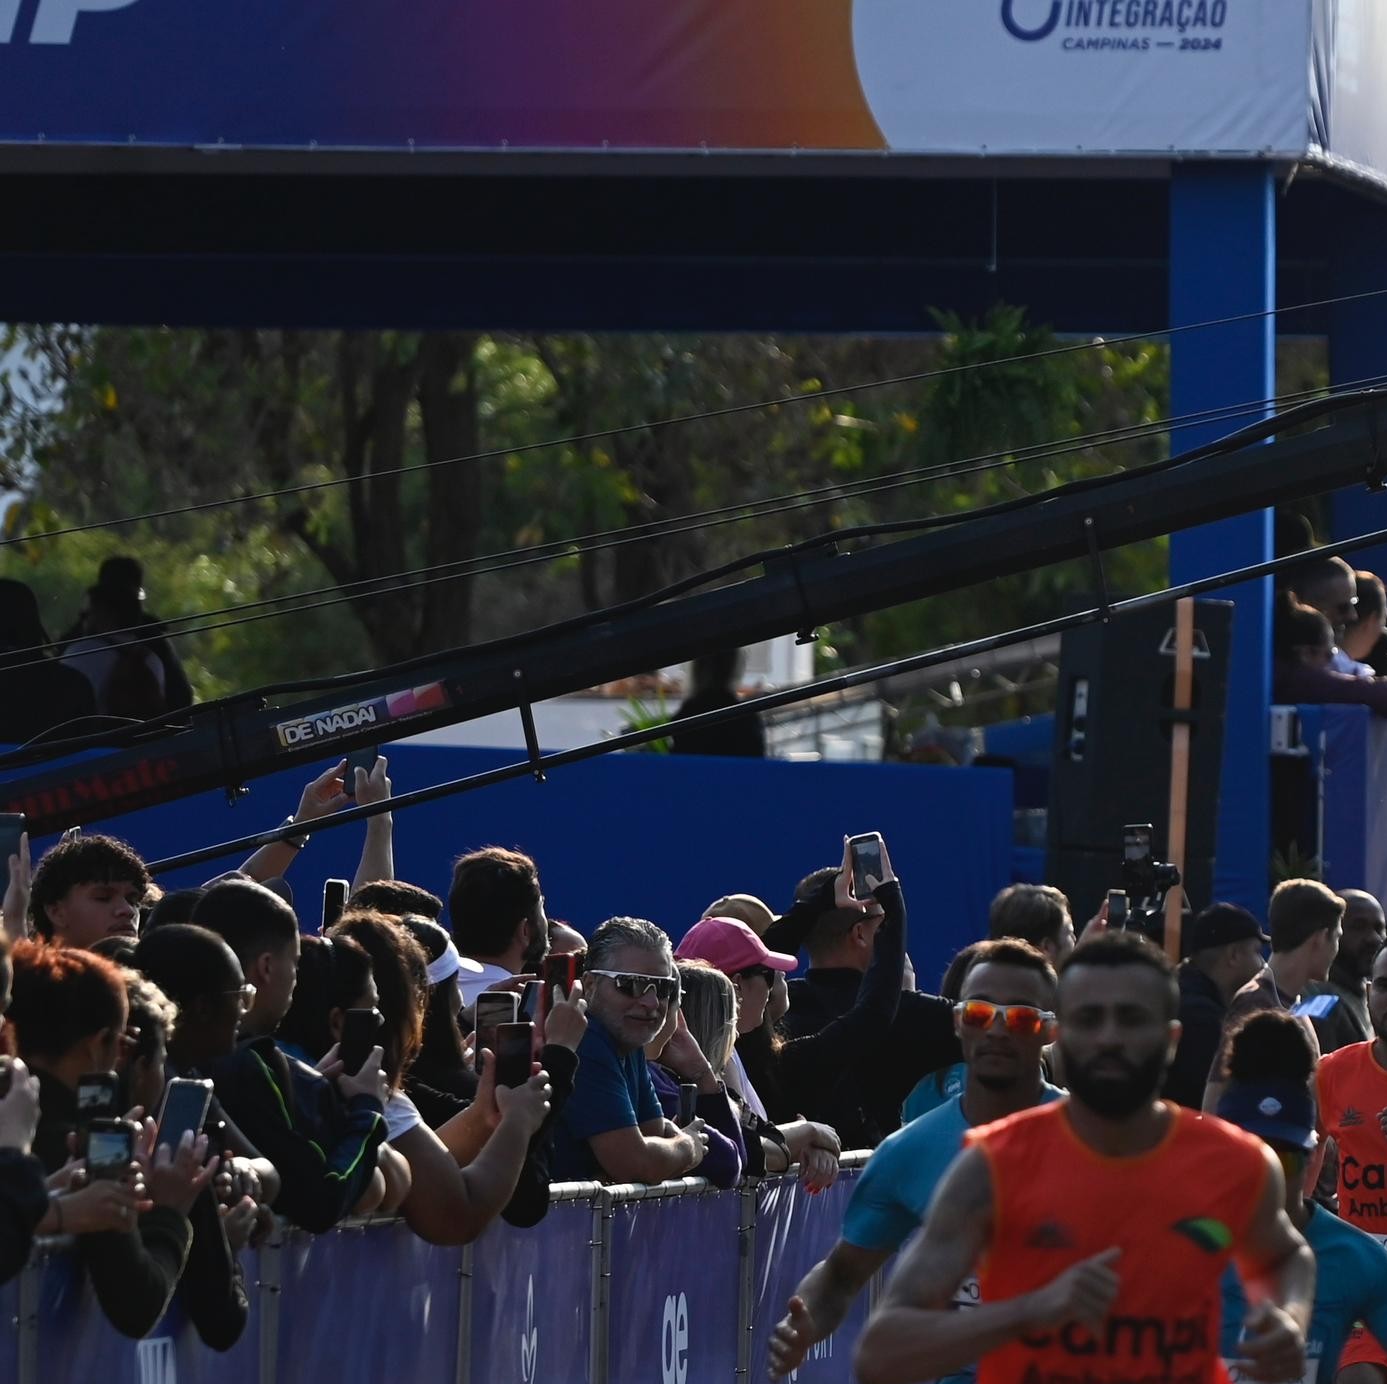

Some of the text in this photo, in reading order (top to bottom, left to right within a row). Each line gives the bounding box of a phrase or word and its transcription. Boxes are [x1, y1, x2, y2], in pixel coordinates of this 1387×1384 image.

[1062, 37, 1223, 51] CAMPINAS 2024
[284, 722, 314, 744] DE
[316, 705, 376, 736] NADAI
